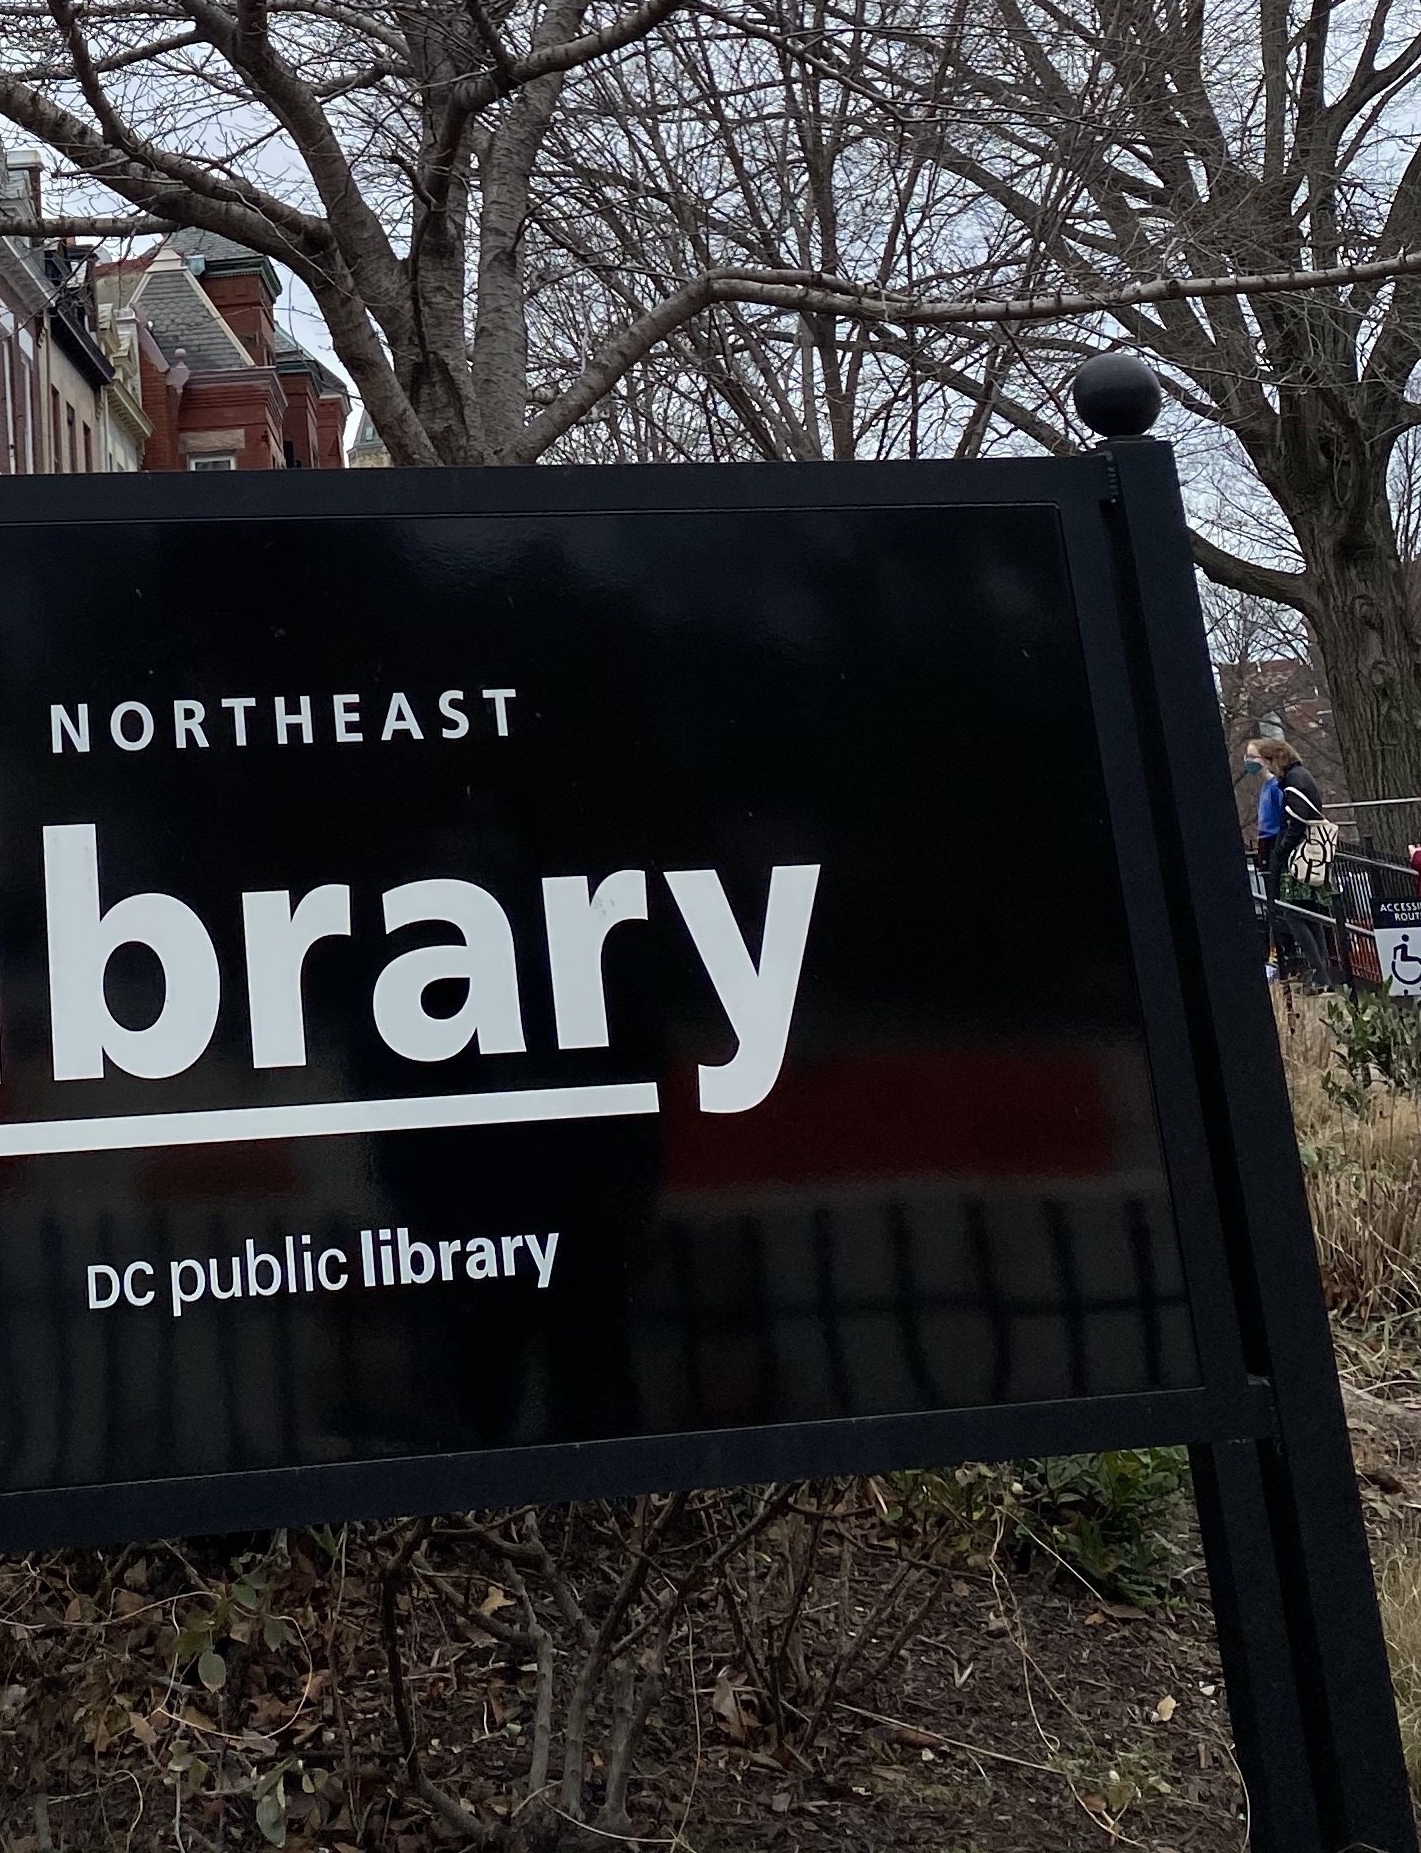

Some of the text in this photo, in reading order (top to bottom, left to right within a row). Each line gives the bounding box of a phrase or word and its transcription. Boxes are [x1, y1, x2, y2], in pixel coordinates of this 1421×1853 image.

[50, 688, 517, 754] NORTHEAST
[1379, 902, 1421, 913] ACCESSI
[1394, 912, 1421, 922] ROUT
[87, 1227, 560, 1317] DC public library
